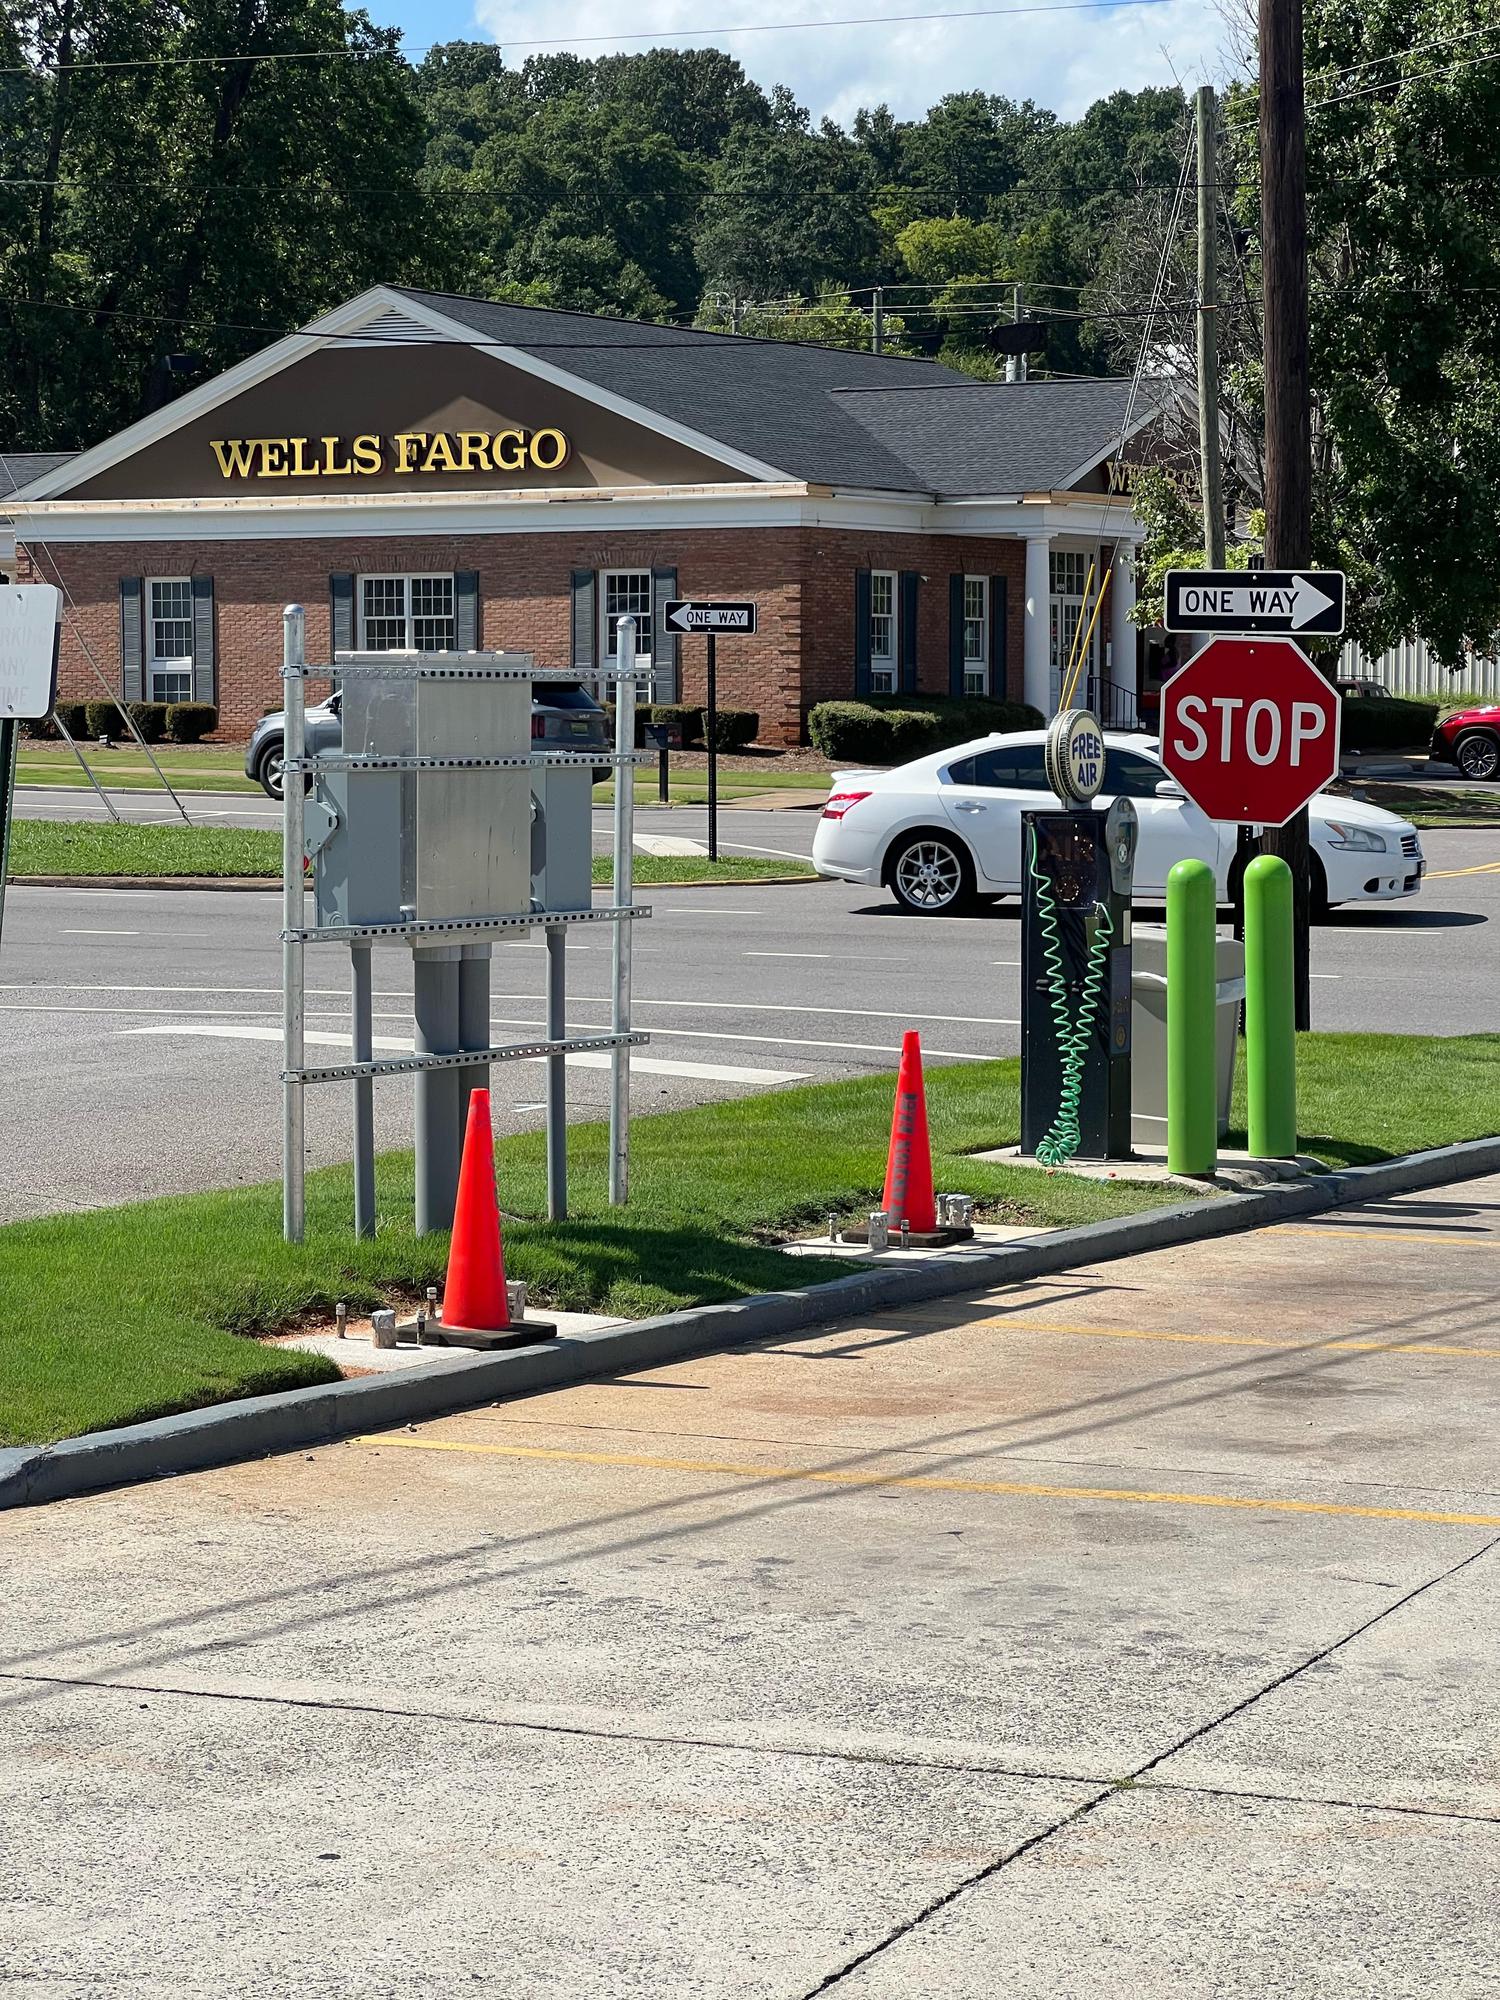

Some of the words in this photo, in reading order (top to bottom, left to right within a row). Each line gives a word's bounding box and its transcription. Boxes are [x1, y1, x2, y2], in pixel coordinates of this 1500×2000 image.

[209, 434, 382, 478] WELLS
[394, 428, 568, 473] FARGO
[1185, 590, 1234, 613] ONE
[1249, 591, 1300, 614] WAY
[686, 611, 711, 624] ONE
[718, 612, 745, 624] WAY
[1173, 695, 1326, 767] STOP
[1071, 732, 1101, 760] FREE
[1077, 763, 1098, 787] AIR
